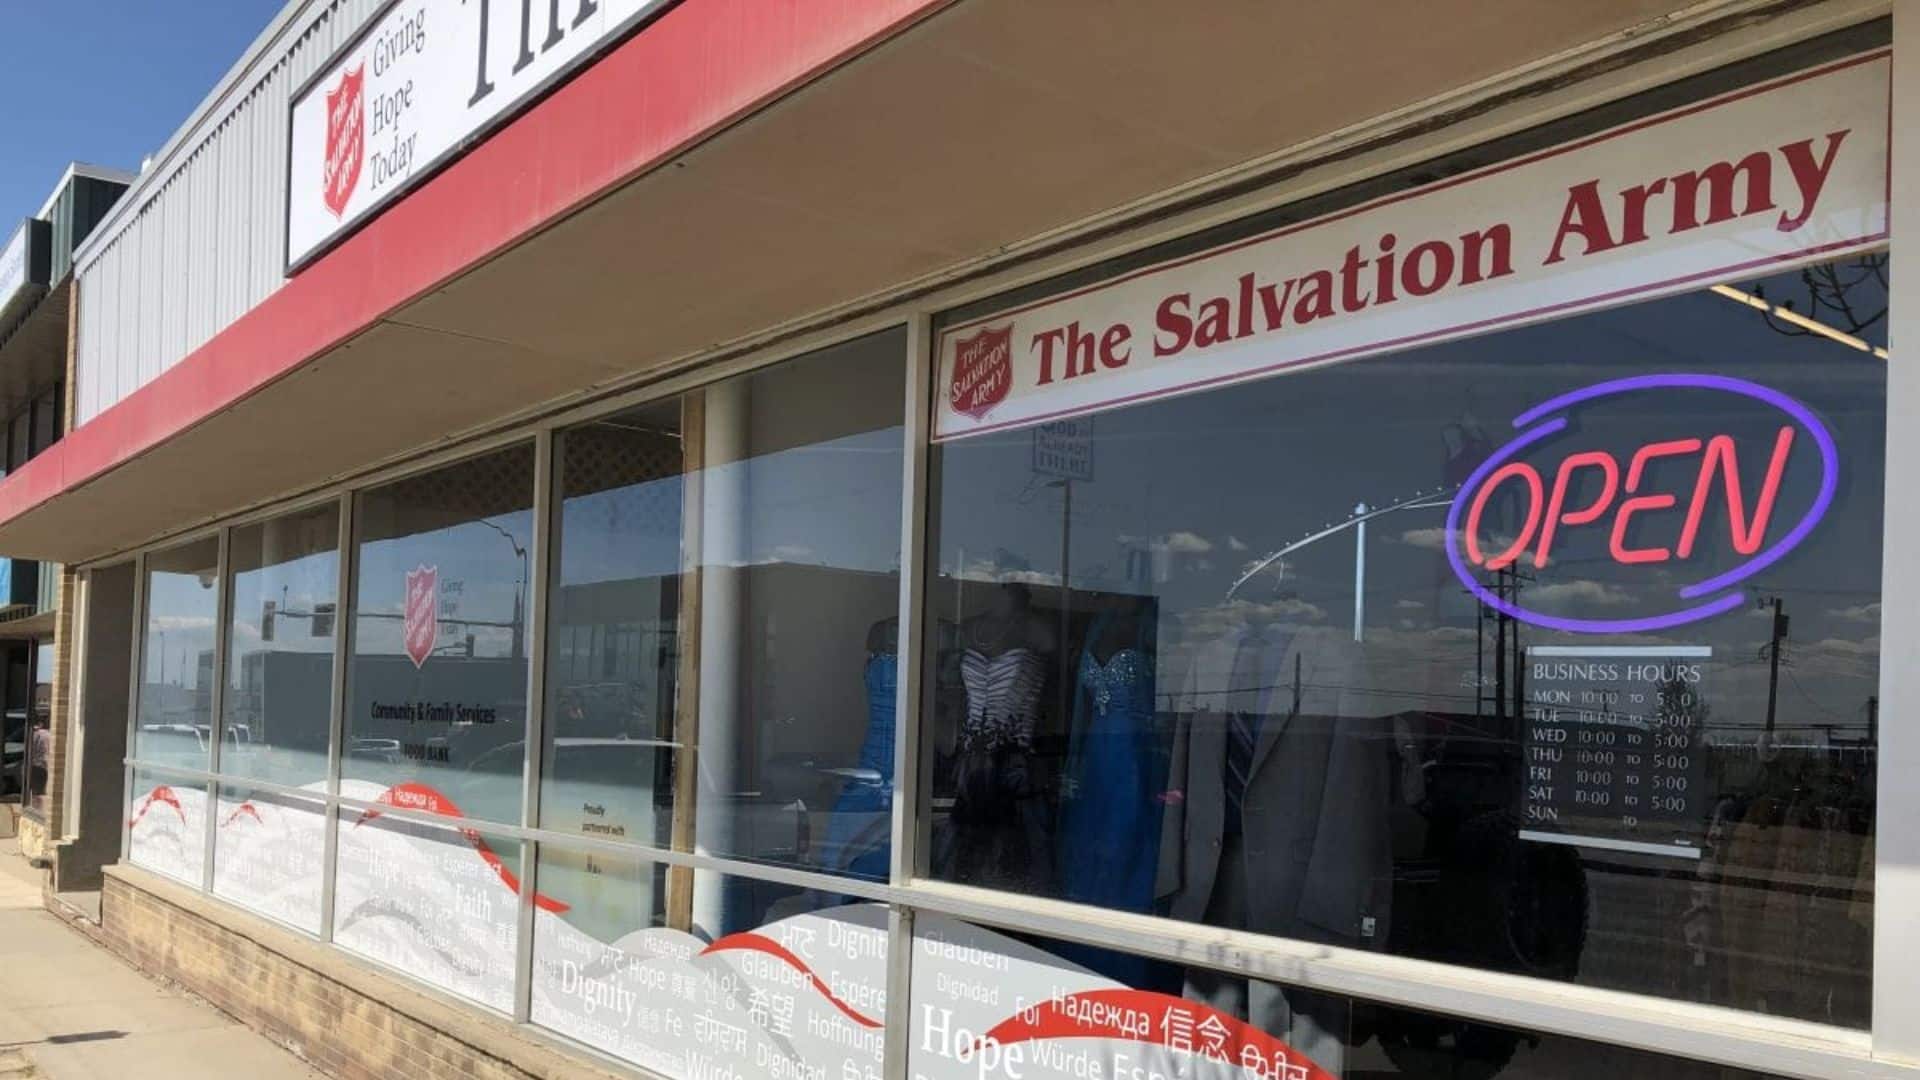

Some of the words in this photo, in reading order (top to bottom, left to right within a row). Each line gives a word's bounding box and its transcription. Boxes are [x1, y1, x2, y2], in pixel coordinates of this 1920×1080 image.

[373, 8, 425, 77] Giving
[372, 79, 413, 136] Hope
[370, 133, 418, 191] Today
[1030, 320, 1133, 386] The
[1152, 222, 1514, 358] Salvation
[1542, 128, 1851, 267] Army
[952, 337, 1008, 402] SALVATION
[961, 337, 987, 368] THE
[970, 363, 1006, 411] ARMY
[1465, 425, 1795, 570] OPEN
[1533, 663, 1618, 681] BUSINESS
[1627, 665, 1701, 683] HOURS
[370, 701, 415, 725] Community
[426, 702, 455, 727] Family
[456, 703, 496, 724] Services
[1534, 691, 1571, 704] MON
[1534, 709, 1560, 722] TUE
[1655, 713, 1690, 728] 5:00
[1532, 748, 1562, 762] THU
[1576, 751, 1614, 765] 10:00
[1653, 754, 1689, 769] 5:00
[1533, 729, 1567, 743] WED
[1578, 731, 1616, 745] 10:00
[1655, 734, 1688, 748] 5:00
[1529, 786, 1554, 800] SAT
[1575, 791, 1609, 805] 10:00
[1651, 796, 1686, 812] 5:00
[1530, 767, 1551, 781] FRI
[1576, 771, 1611, 785] 10:00
[1653, 776, 1687, 791] 5:00
[1528, 806, 1558, 819] SUN
[924, 929, 1009, 971] Glauben
[629, 956, 665, 992] Hope
[742, 951, 814, 993] Glauben
[936, 971, 1000, 1006] Dignidad
[561, 960, 638, 1028] Dignity
[748, 985, 796, 1038] 希望
[1051, 984, 1151, 1040] Надежда
[664, 1007, 682, 1037] Fe
[807, 1009, 885, 1063] Hoffnung
[920, 1003, 1025, 1080] Hope
[1160, 1006, 1232, 1065] 信念
[756, 1041, 826, 1080] Dignidad
[1030, 1035, 1102, 1080] Würde
[1113, 1053, 1186, 1080] Esp
